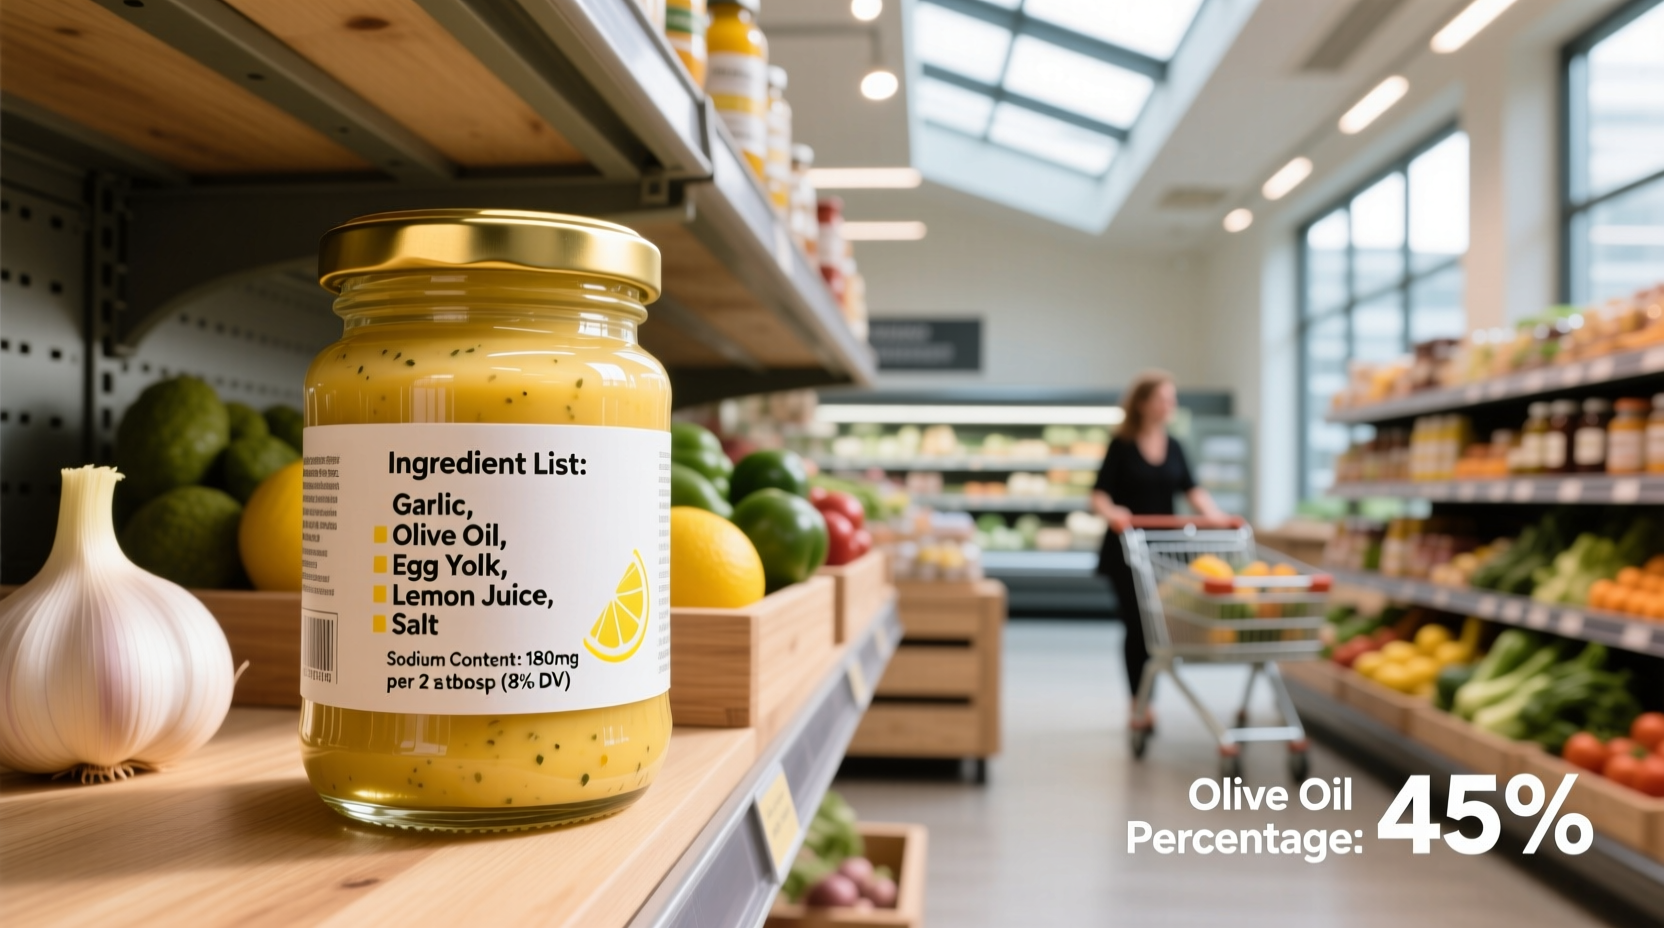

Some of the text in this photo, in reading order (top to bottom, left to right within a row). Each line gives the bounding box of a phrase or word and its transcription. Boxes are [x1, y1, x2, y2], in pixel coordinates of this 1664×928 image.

[388, 450, 587, 480] Ingredient List:
[392, 492, 474, 520] Garlic,
[392, 523, 507, 550] Olive Oil,
[392, 553, 508, 582] Egg Yolk,
[392, 583, 554, 609] Lemon Juice,
[391, 613, 439, 635] Salt
[386, 650, 579, 669] Sodium Content: 180mg
[386, 676, 414, 694] per
[418, 673, 430, 690] 2
[501, 672, 535, 693] (8%
[539, 670, 571, 692] DV)
